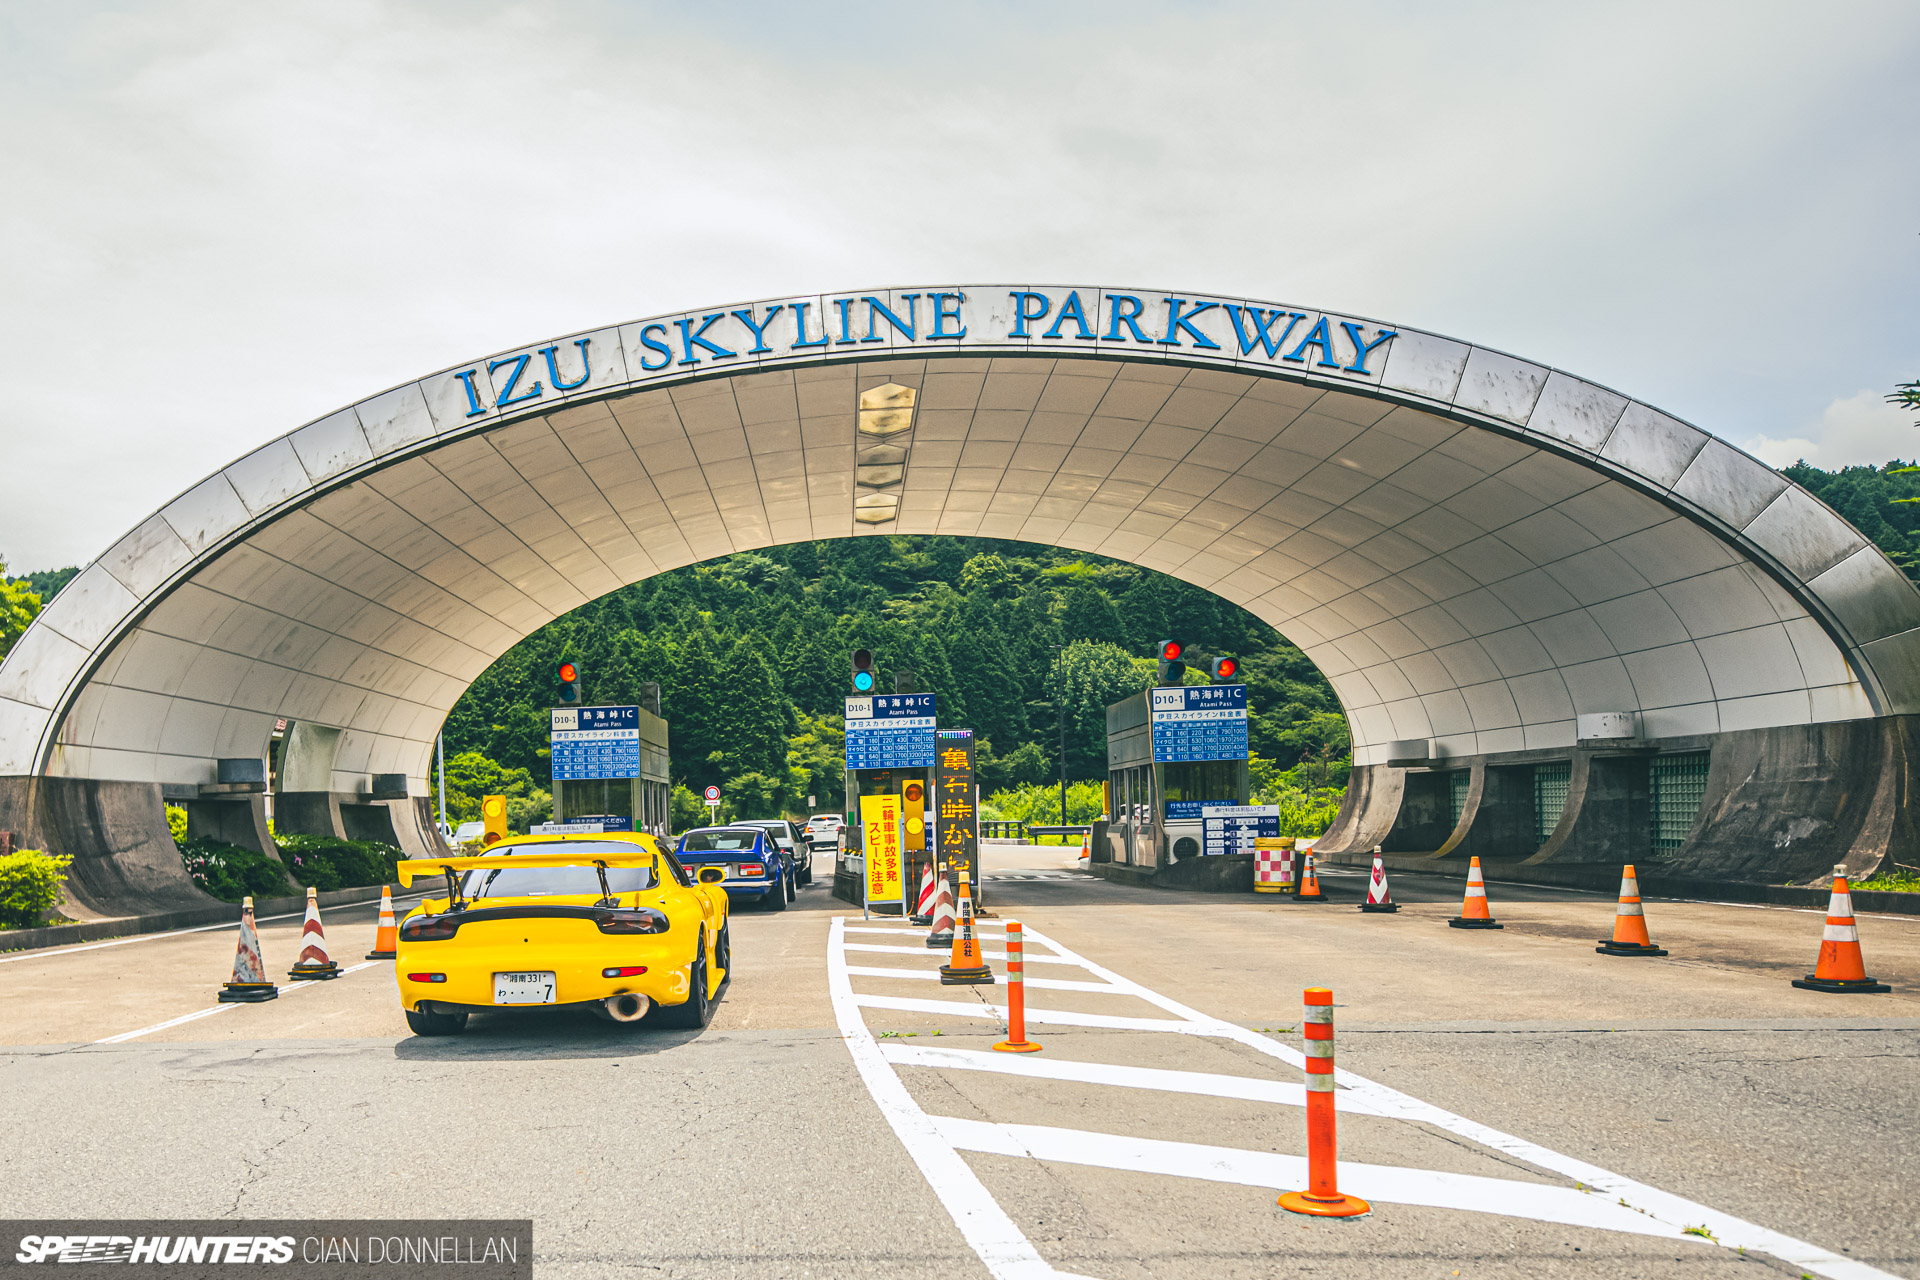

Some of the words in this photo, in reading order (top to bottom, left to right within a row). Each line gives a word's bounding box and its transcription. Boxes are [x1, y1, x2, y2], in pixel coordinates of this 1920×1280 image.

[454, 338, 590, 417] IZU
[640, 292, 968, 371] SKYLINE
[1008, 290, 1398, 375] PARKWAY
[1155, 696, 1182, 704] D10-1
[869, 822, 884, 895] スピード注意
[882, 798, 897, 882] 二輪車事故多発
[528, 974, 541, 982] 331
